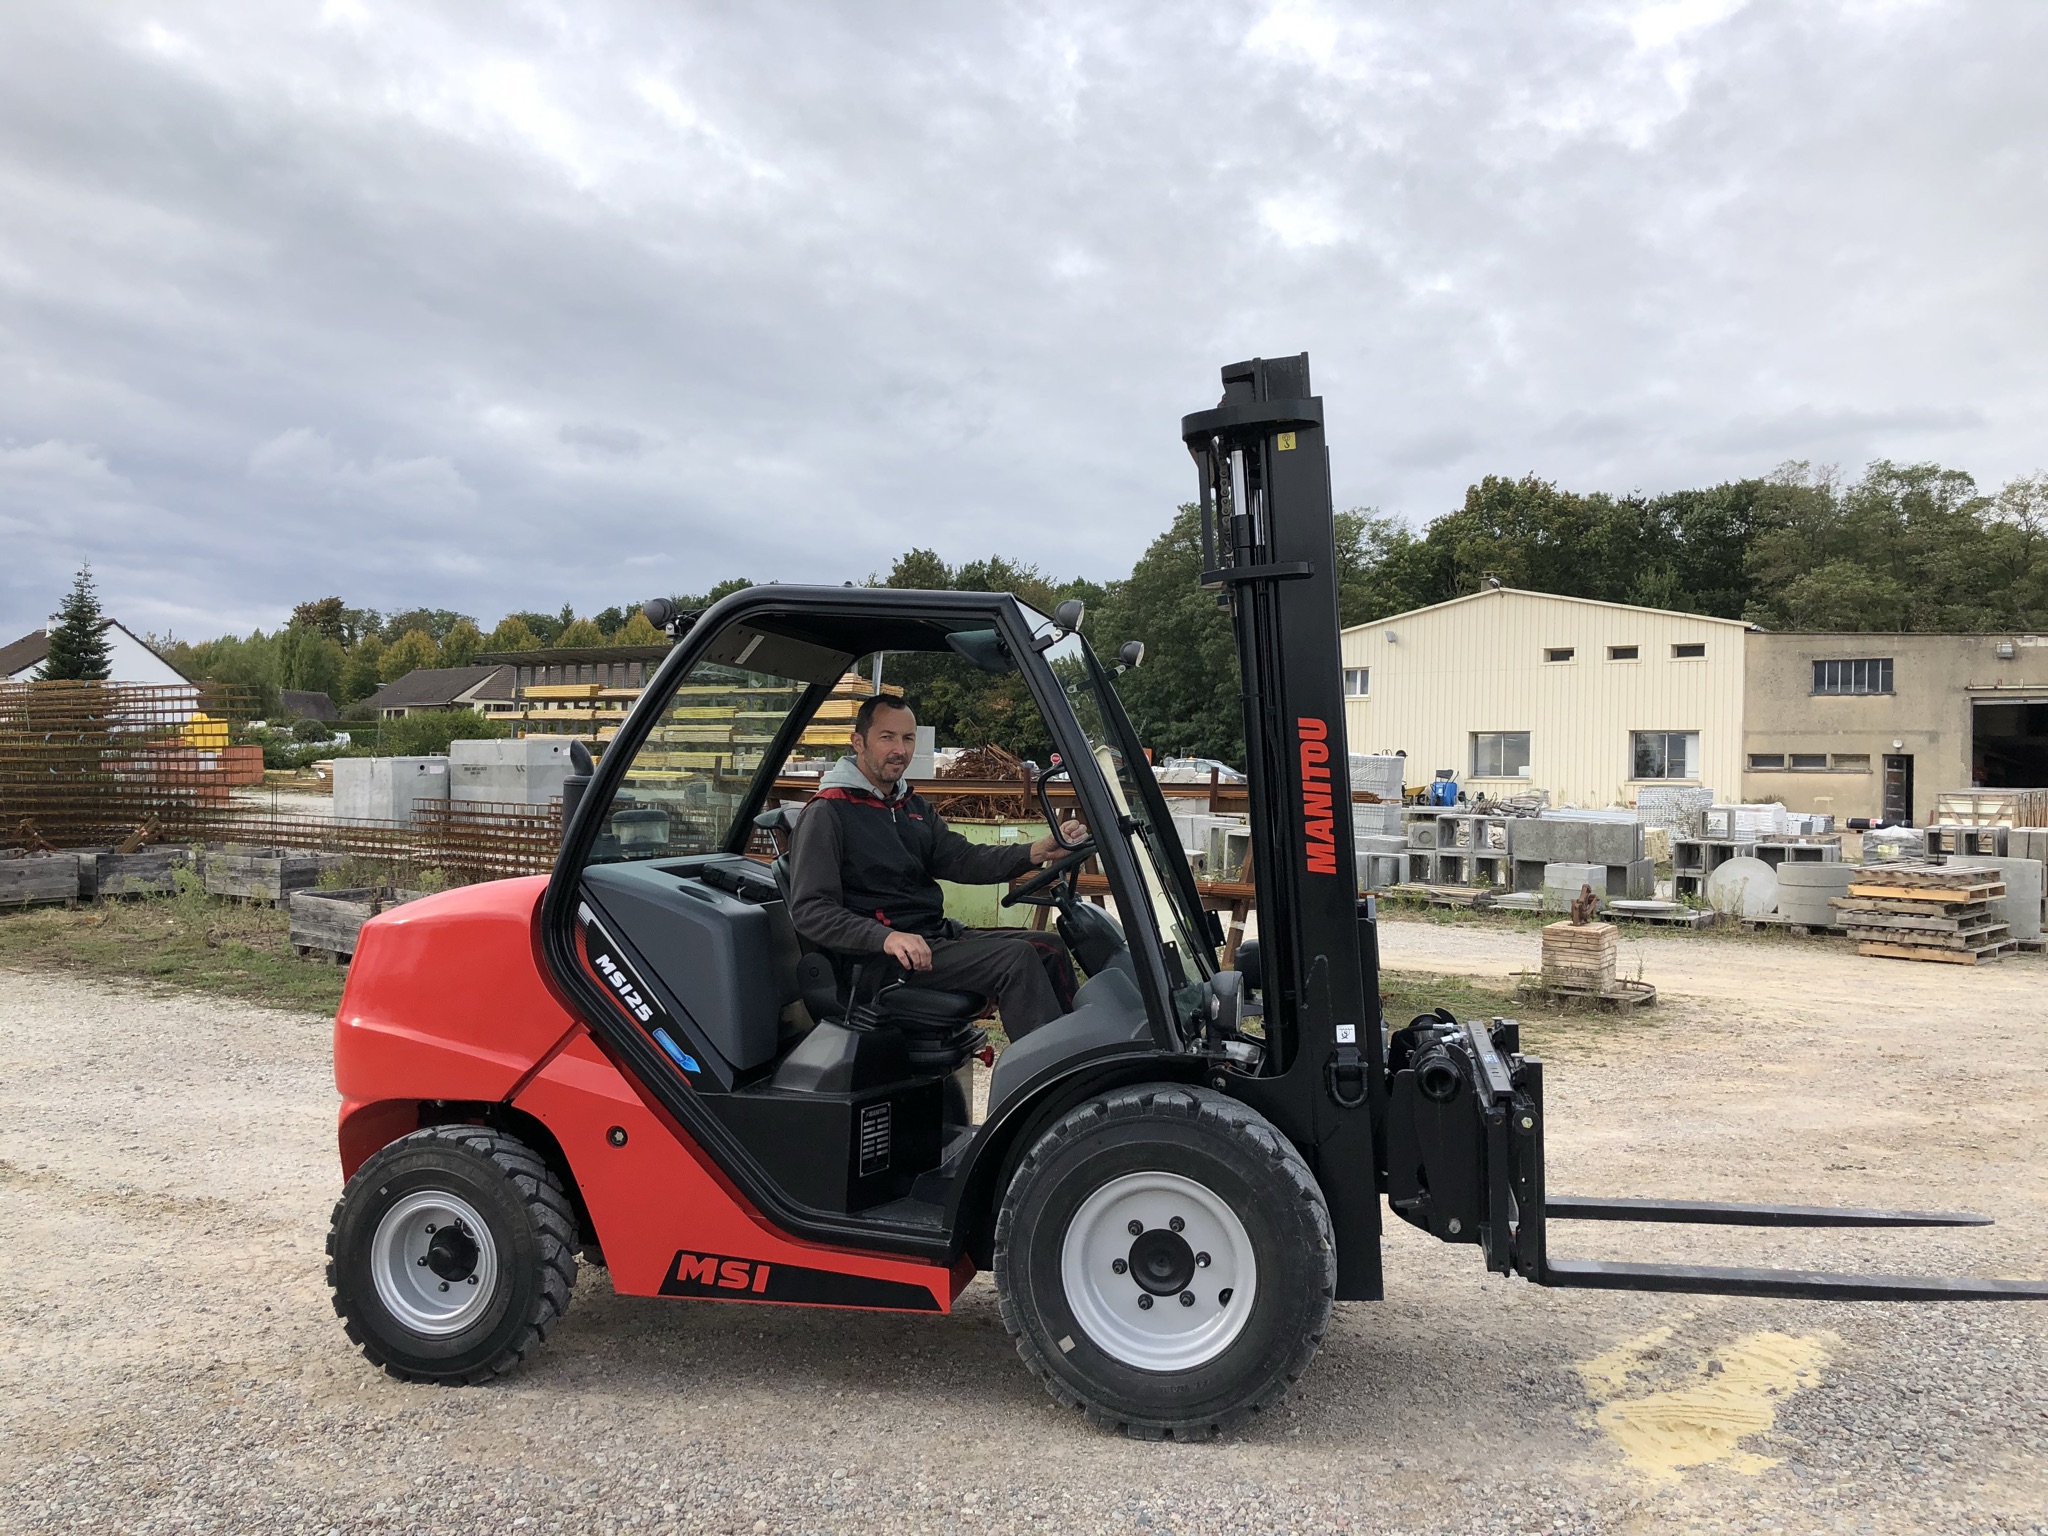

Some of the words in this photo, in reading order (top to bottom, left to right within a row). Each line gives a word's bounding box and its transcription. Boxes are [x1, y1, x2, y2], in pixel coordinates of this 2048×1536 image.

[1298, 717, 1337, 875] MANITOU
[595, 954, 654, 1021] MSI25
[676, 1254, 771, 1293] MSI
